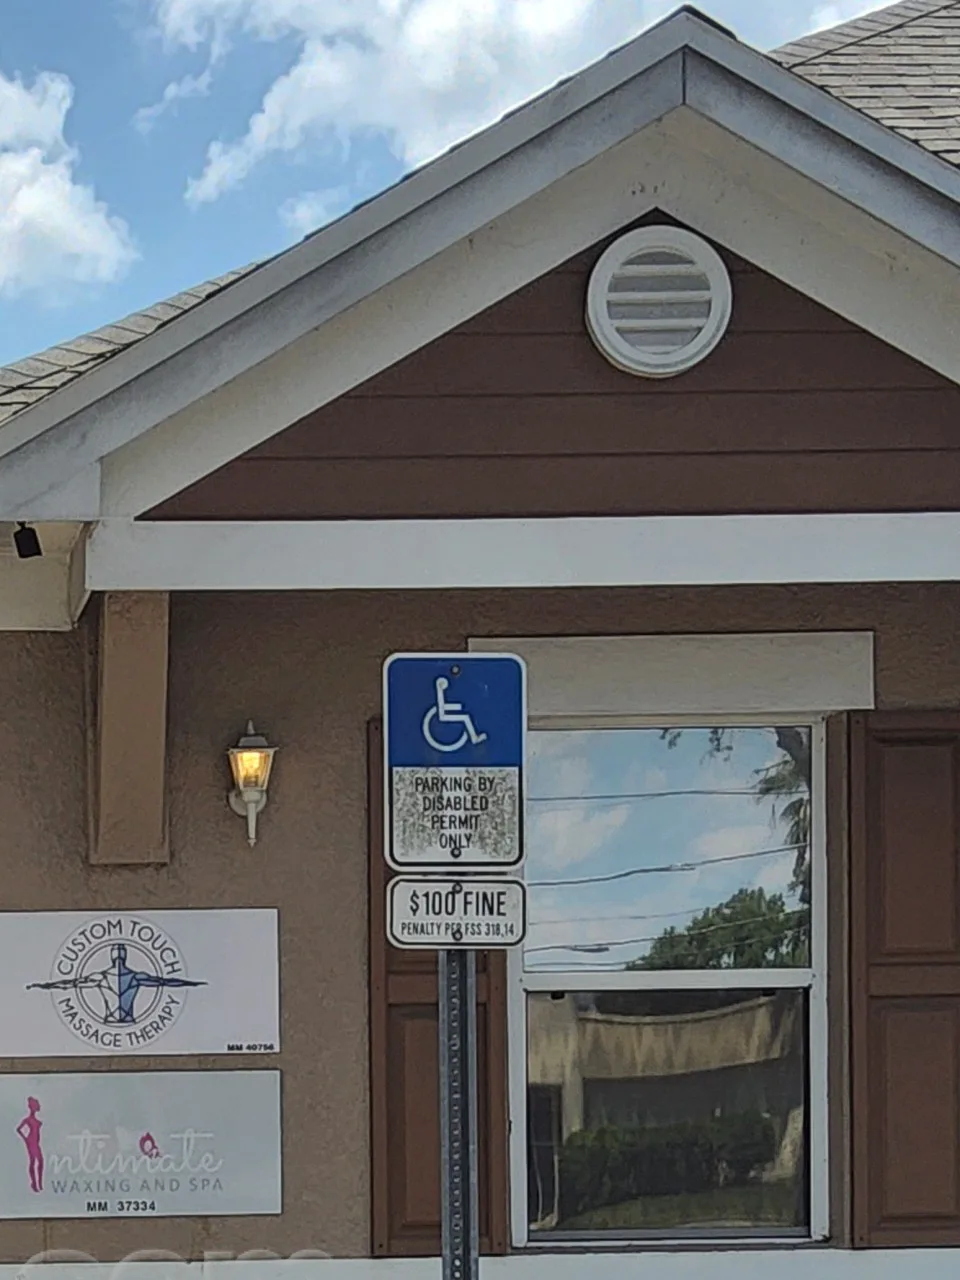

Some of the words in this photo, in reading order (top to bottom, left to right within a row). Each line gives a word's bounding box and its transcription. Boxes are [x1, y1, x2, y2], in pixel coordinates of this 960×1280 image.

[414, 776, 473, 793] PARKING
[478, 776, 496, 792] BY
[422, 795, 489, 812] DISABLED
[431, 814, 481, 830] PERMIT
[439, 832, 473, 849] ONLY
[409, 889, 456, 917] $100
[463, 890, 507, 917] FINE
[401, 921, 442, 936] PENALTY
[464, 922, 482, 937] FSS
[56, 918, 124, 977] CUSTOM
[128, 920, 183, 976] TOUCH
[57, 996, 123, 1048] MASSAGE
[125, 993, 182, 1047] THERAPY
[51, 1178, 132, 1195] WAXING
[139, 1178, 181, 1193] AND
[188, 1177, 224, 1193] SPA
[86, 1201, 109, 1212] MM
[116, 1200, 157, 1212] 37334
